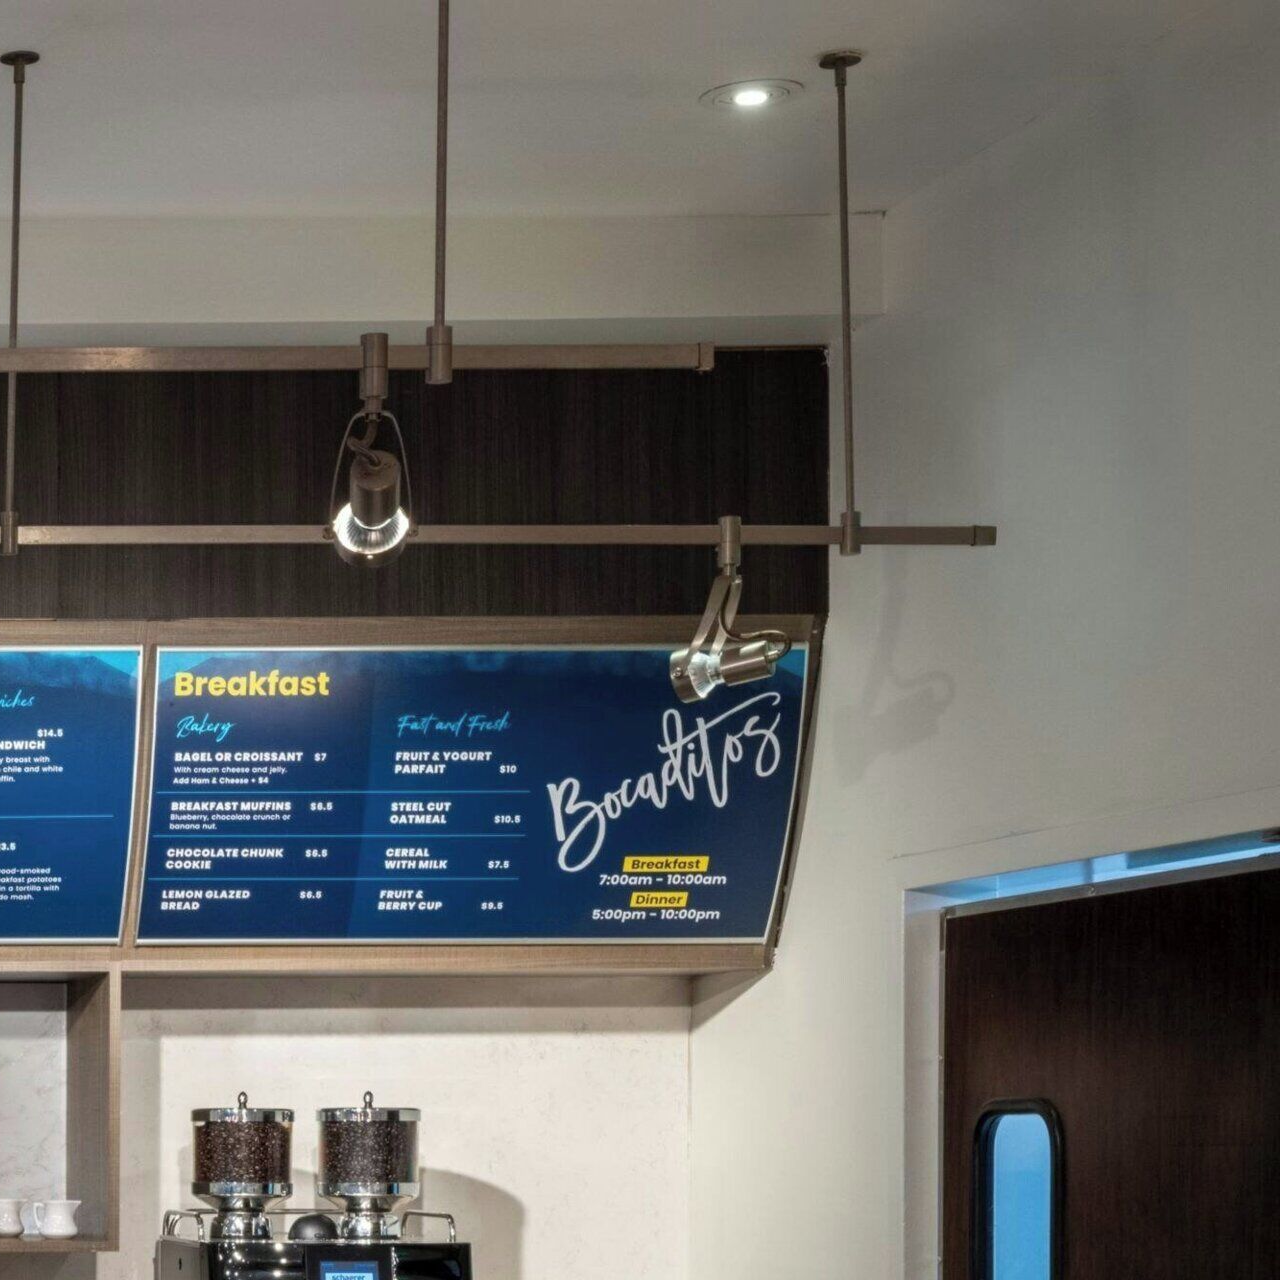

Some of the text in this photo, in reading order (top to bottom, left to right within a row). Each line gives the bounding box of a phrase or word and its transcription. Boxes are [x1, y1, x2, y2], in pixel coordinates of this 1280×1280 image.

[174, 670, 330, 697] Breakfast
[176, 713, 235, 743] Bakery
[397, 711, 512, 738] Fast and Fresh
[37, 728, 63, 739] $14.5
[175, 751, 326, 763] BAGEL OR CROISSANT $7
[396, 751, 492, 762] FRUIT & YOGURT
[174, 765, 287, 776] With cream cheese and jelly.
[395, 763, 516, 775] PARFAIT $10
[547, 692, 781, 873] Bocaditos
[171, 801, 291, 812] BREAKFAST MUFFINS
[391, 801, 451, 812] STEEL CUT
[390, 814, 446, 825] OATMEAL
[167, 848, 283, 859] CHOCOLATE CHUNK
[165, 860, 211, 870] COOKIE
[631, 858, 701, 870] Breakfast
[599, 874, 652, 885] 7:00am
[667, 874, 727, 885] 10:00am
[636, 894, 683, 905] Dinner
[592, 909, 646, 923] 5:00pm
[661, 909, 720, 923] 10:00pm
